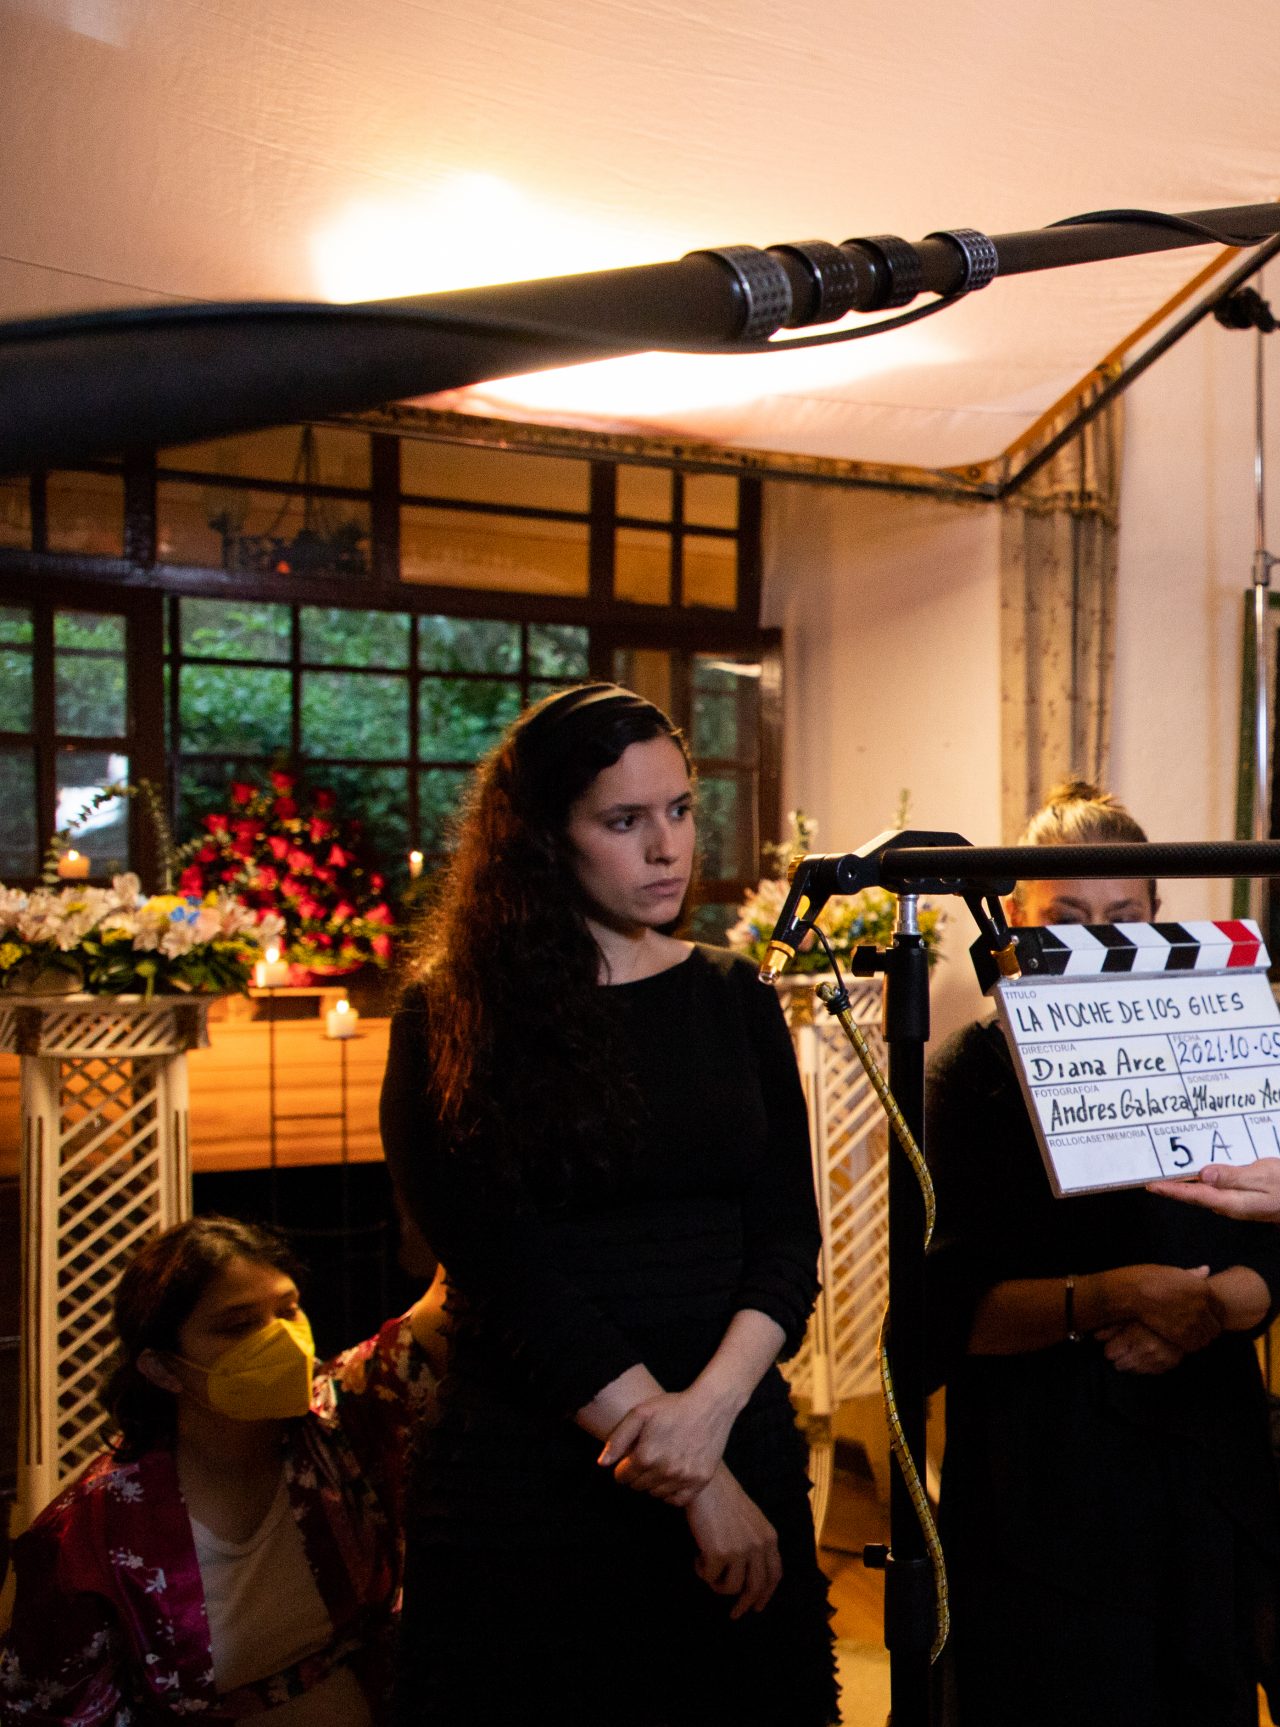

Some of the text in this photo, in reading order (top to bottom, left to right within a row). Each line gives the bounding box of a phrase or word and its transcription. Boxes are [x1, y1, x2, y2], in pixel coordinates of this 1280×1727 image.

[1004, 990, 1037, 1000] TITULO
[1016, 1005, 1044, 1032] LA
[1047, 1001, 1114, 1032] NOCHE
[1117, 1000, 1145, 1024] DE
[1188, 992, 1245, 1016] GILES
[1030, 1047, 1167, 1081] Diana Arce
[1050, 1087, 1192, 1132] Andres Galarza
[1192, 1084, 1256, 1118] Mauricio
[1249, 1115, 1273, 1125] TOMA
[1169, 1129, 1233, 1168] 5 A
